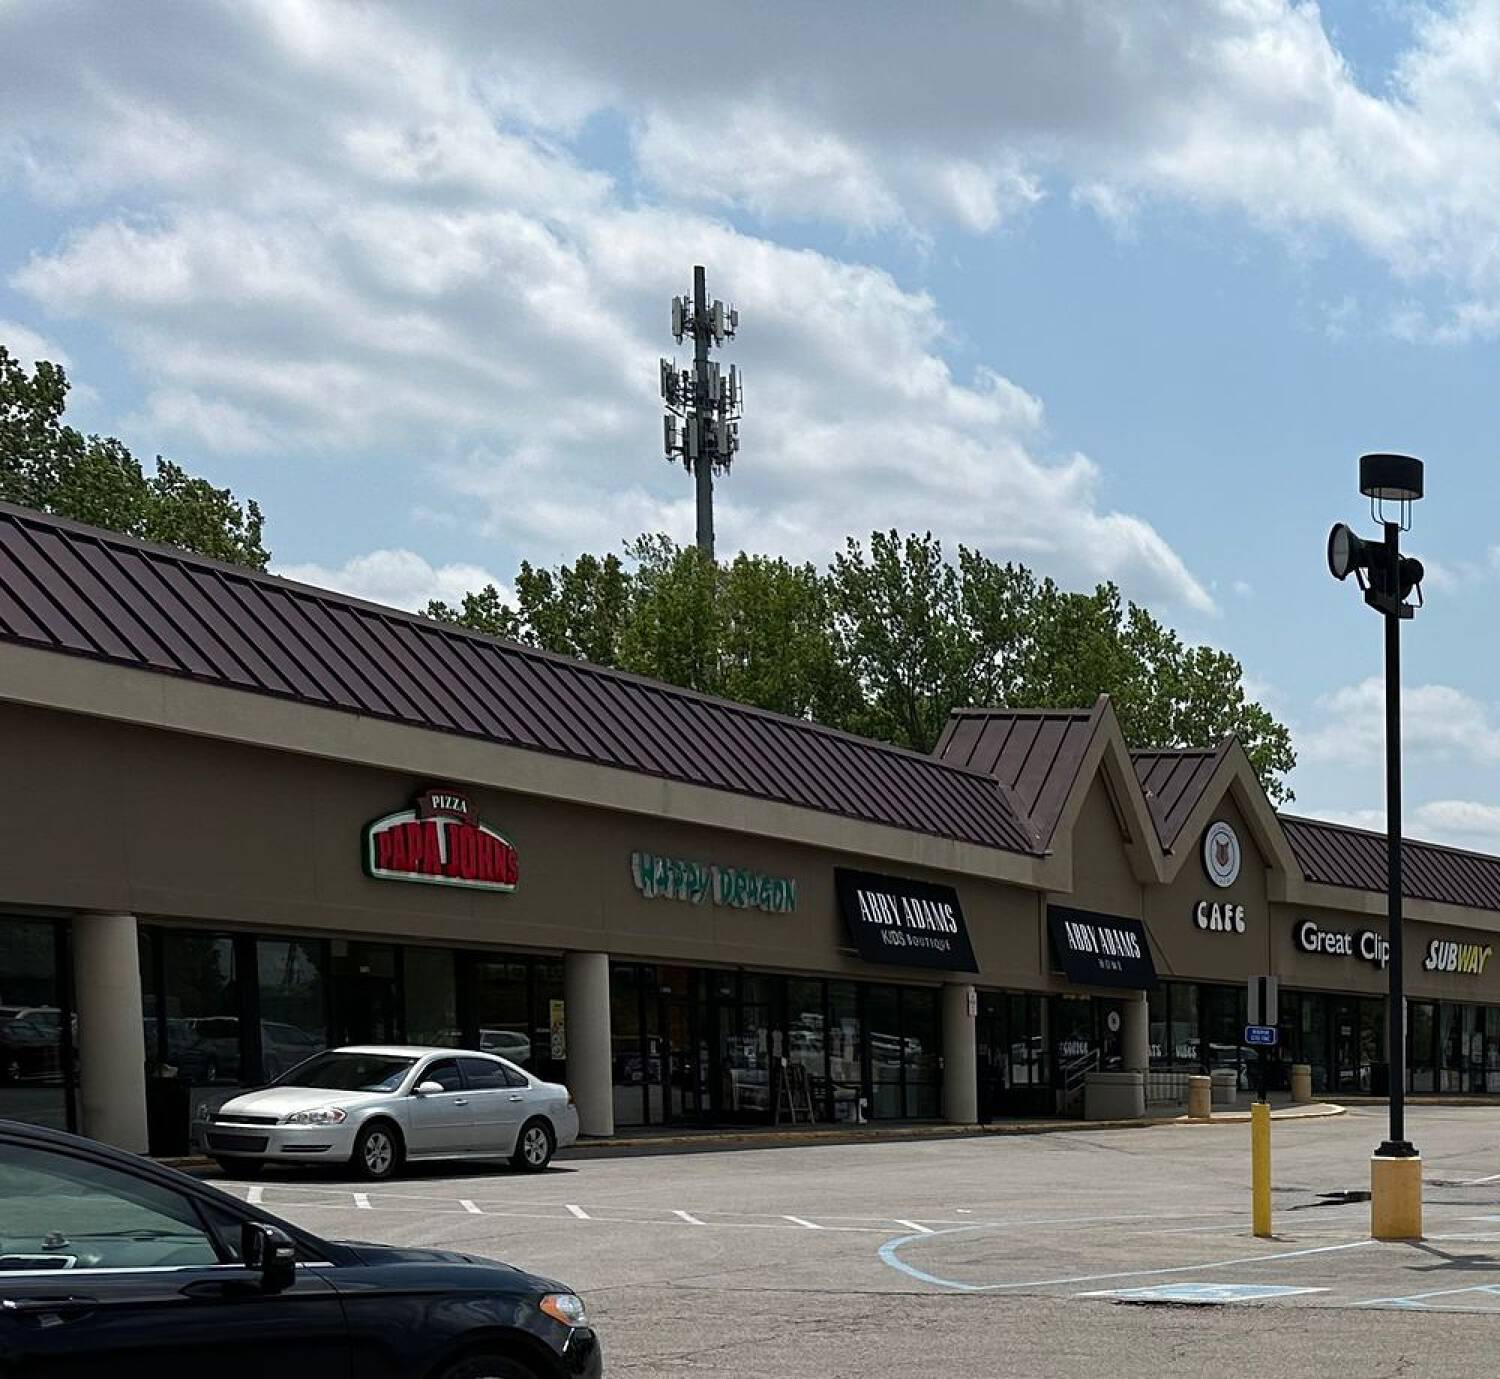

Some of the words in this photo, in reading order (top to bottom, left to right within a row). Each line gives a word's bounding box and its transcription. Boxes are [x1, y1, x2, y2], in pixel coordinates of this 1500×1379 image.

[431, 795, 468, 813] PIZZA
[377, 821, 442, 875] PAPA
[632, 852, 711, 905] HAPPY
[711, 865, 798, 913] DRAGON
[857, 889, 902, 926] ABBY
[901, 896, 958, 933] ADAMS
[1196, 901, 1246, 933] CAFE
[881, 929, 906, 947] KIDS
[1064, 920, 1099, 954] ABBY
[1098, 926, 1141, 958] ADAMS
[1301, 921, 1352, 955] Great
[1361, 931, 1390, 969] Clip
[1425, 940, 1493, 975] SUBWAY
